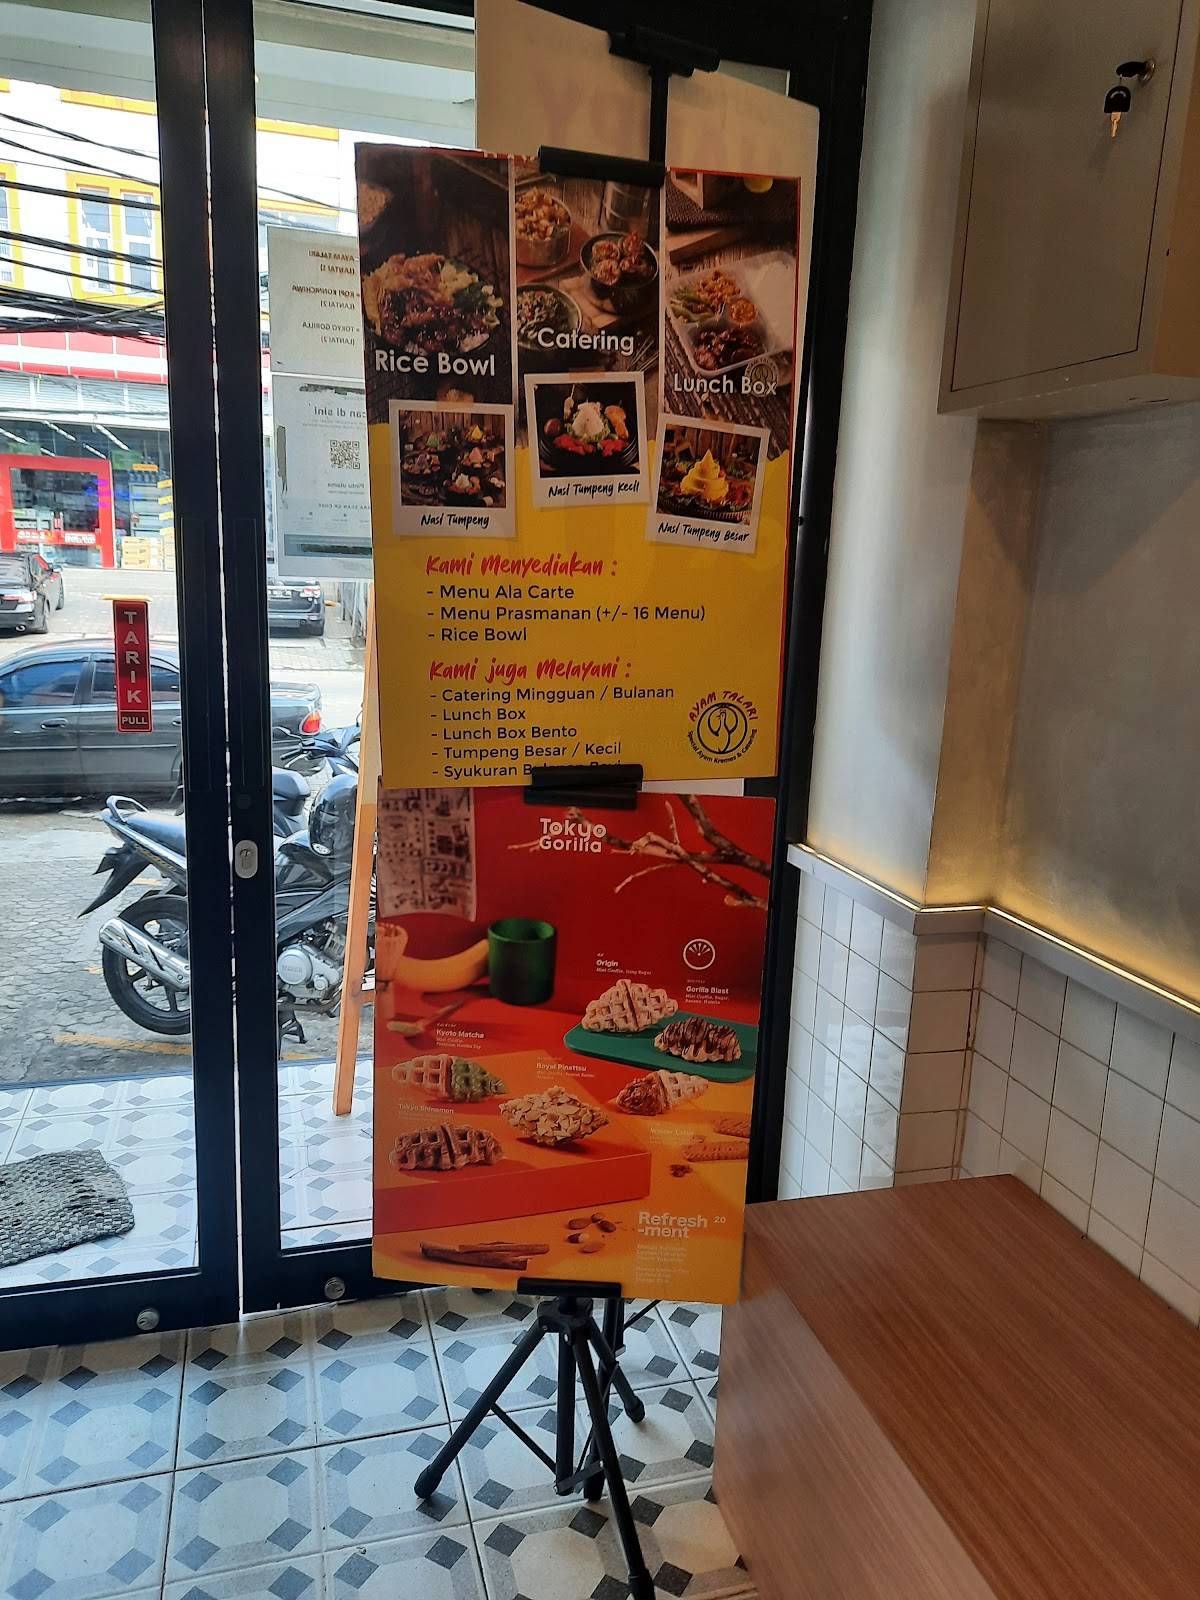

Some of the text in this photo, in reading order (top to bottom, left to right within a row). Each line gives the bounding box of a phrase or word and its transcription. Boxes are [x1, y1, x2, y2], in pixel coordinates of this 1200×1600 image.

[537, 327, 635, 356] Catering
[375, 349, 496, 377] Rice Bowl
[674, 373, 777, 396] Lunch Box
[548, 484, 570, 498] Nasi
[572, 483, 614, 498] Tumpeng
[420, 513, 490, 529] Nasi Tumpeng
[657, 521, 750, 543] Nasi Tumpeng Besar
[426, 552, 476, 577] Kami
[480, 551, 604, 578] Menyediakan
[440, 584, 490, 599] Menu
[495, 584, 523, 599] Ala
[527, 584, 575, 599] Carte
[440, 606, 490, 621] Menu
[496, 606, 591, 621] Prasmanan
[633, 606, 649, 621] 16
[655, 605, 706, 622] Menu)
[441, 627, 479, 641] Rice
[485, 626, 528, 641] Bowl
[123, 611, 142, 704] TARIK
[429, 657, 479, 681] Kami
[485, 657, 527, 686] juga
[536, 656, 620, 681] Melayani
[442, 688, 511, 704] Catering
[516, 687, 596, 703] Mingguan
[612, 686, 674, 700] Bulanan
[443, 708, 491, 721] Lunch
[497, 708, 526, 721] Box
[689, 690, 759, 722] AYAM TALARI
[121, 716, 148, 725] PULL
[443, 727, 492, 740] Lunch
[497, 727, 526, 740] Box
[531, 725, 578, 739] Bento
[443, 746, 519, 761] Tumpeng
[524, 745, 568, 758] Besar
[585, 741, 622, 756] Kecil
[444, 765, 518, 780] Syukuran
[539, 817, 607, 842] Tokyo
[539, 836, 603, 854] Gorilla
[596, 959, 619, 968] Origin
[686, 985, 709, 994] Gorilla
[436, 1028, 485, 1039] Kyoto Matcha
[638, 1210, 727, 1228] Refresh 20
